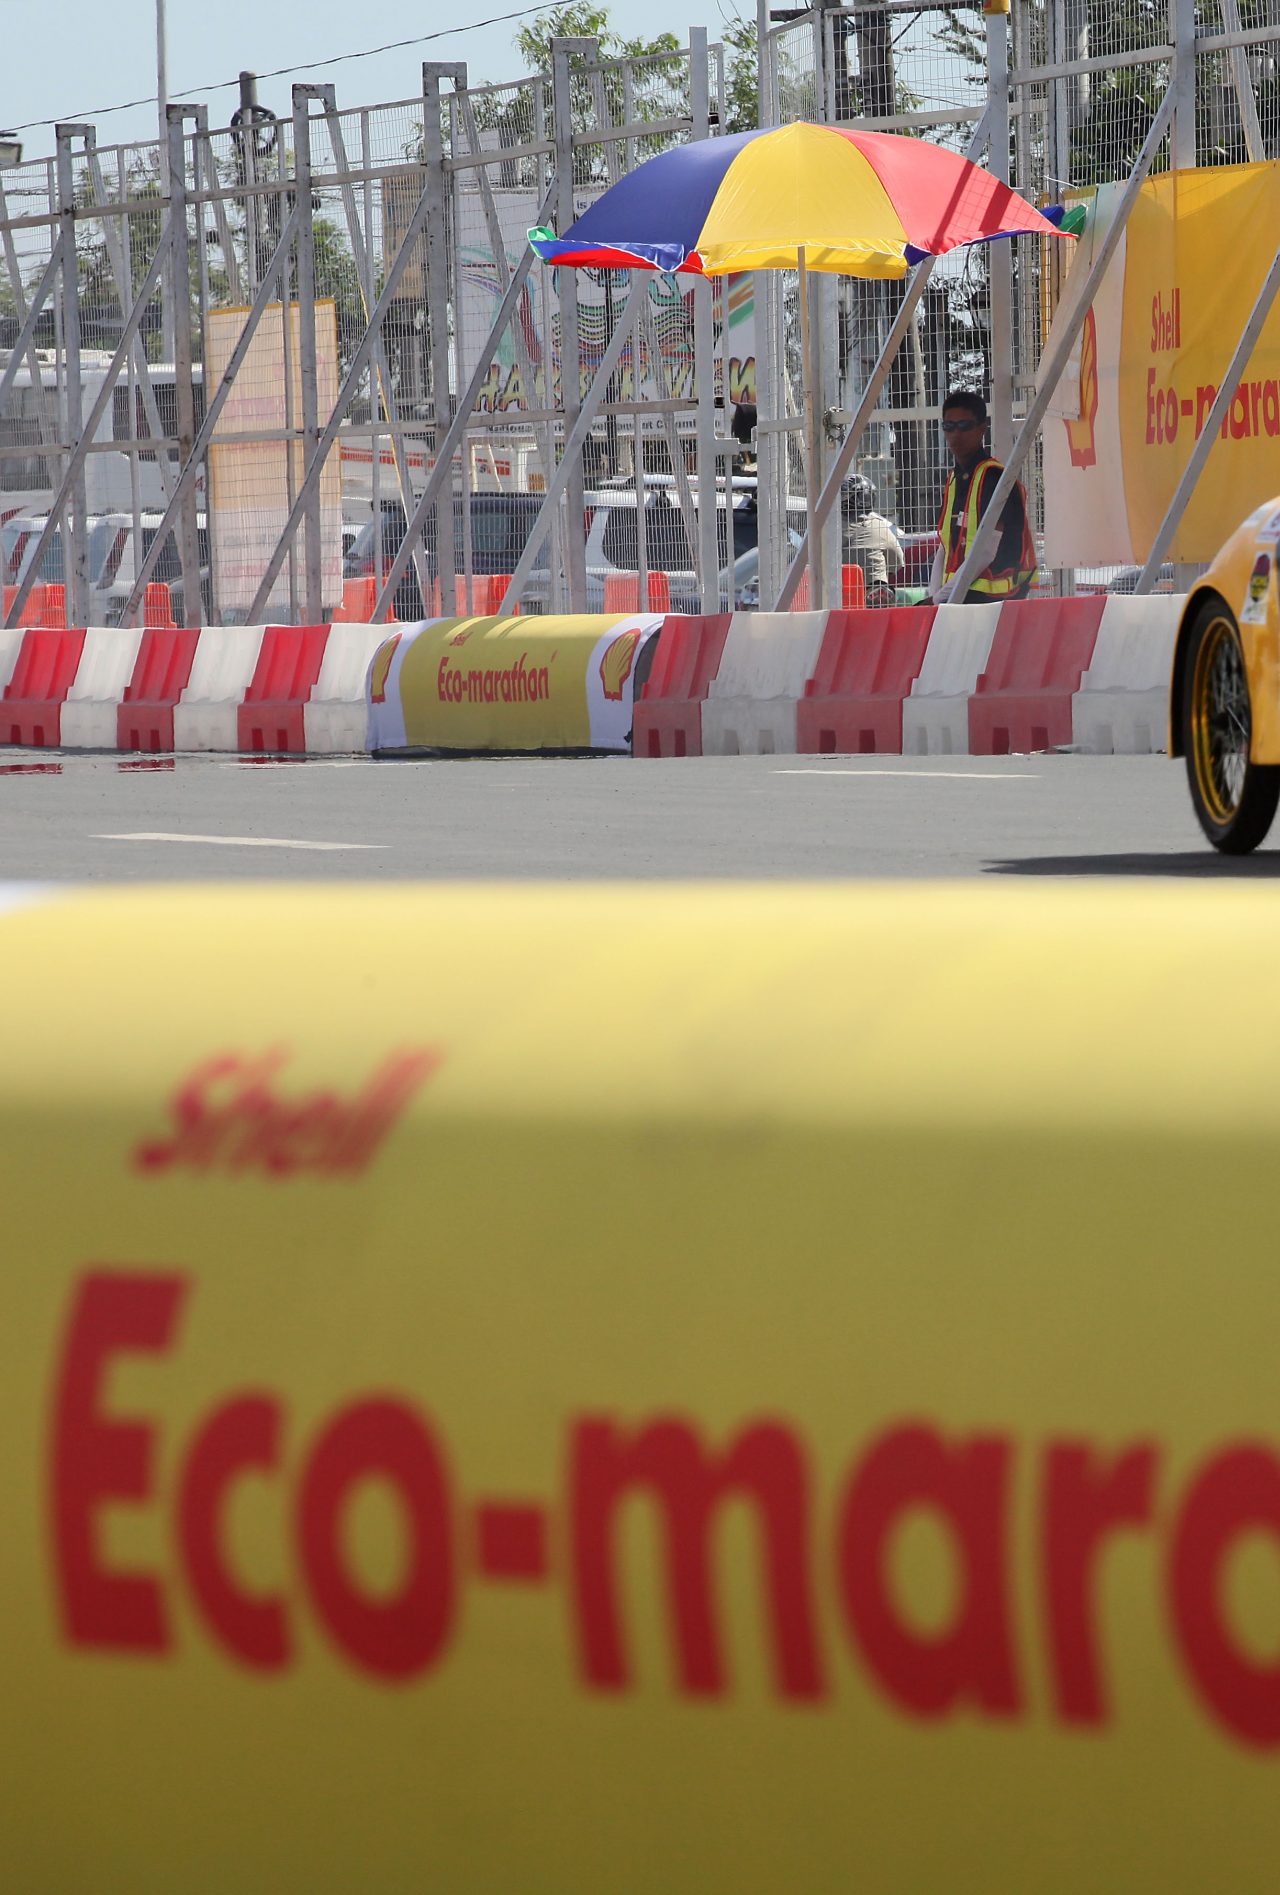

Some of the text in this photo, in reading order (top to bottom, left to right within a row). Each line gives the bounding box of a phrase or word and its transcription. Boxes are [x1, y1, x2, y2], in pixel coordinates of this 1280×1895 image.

[1150, 287, 1181, 353] Shell
[437, 652, 549, 703] Eco-marathon
[130, 1042, 442, 1182] Shell
